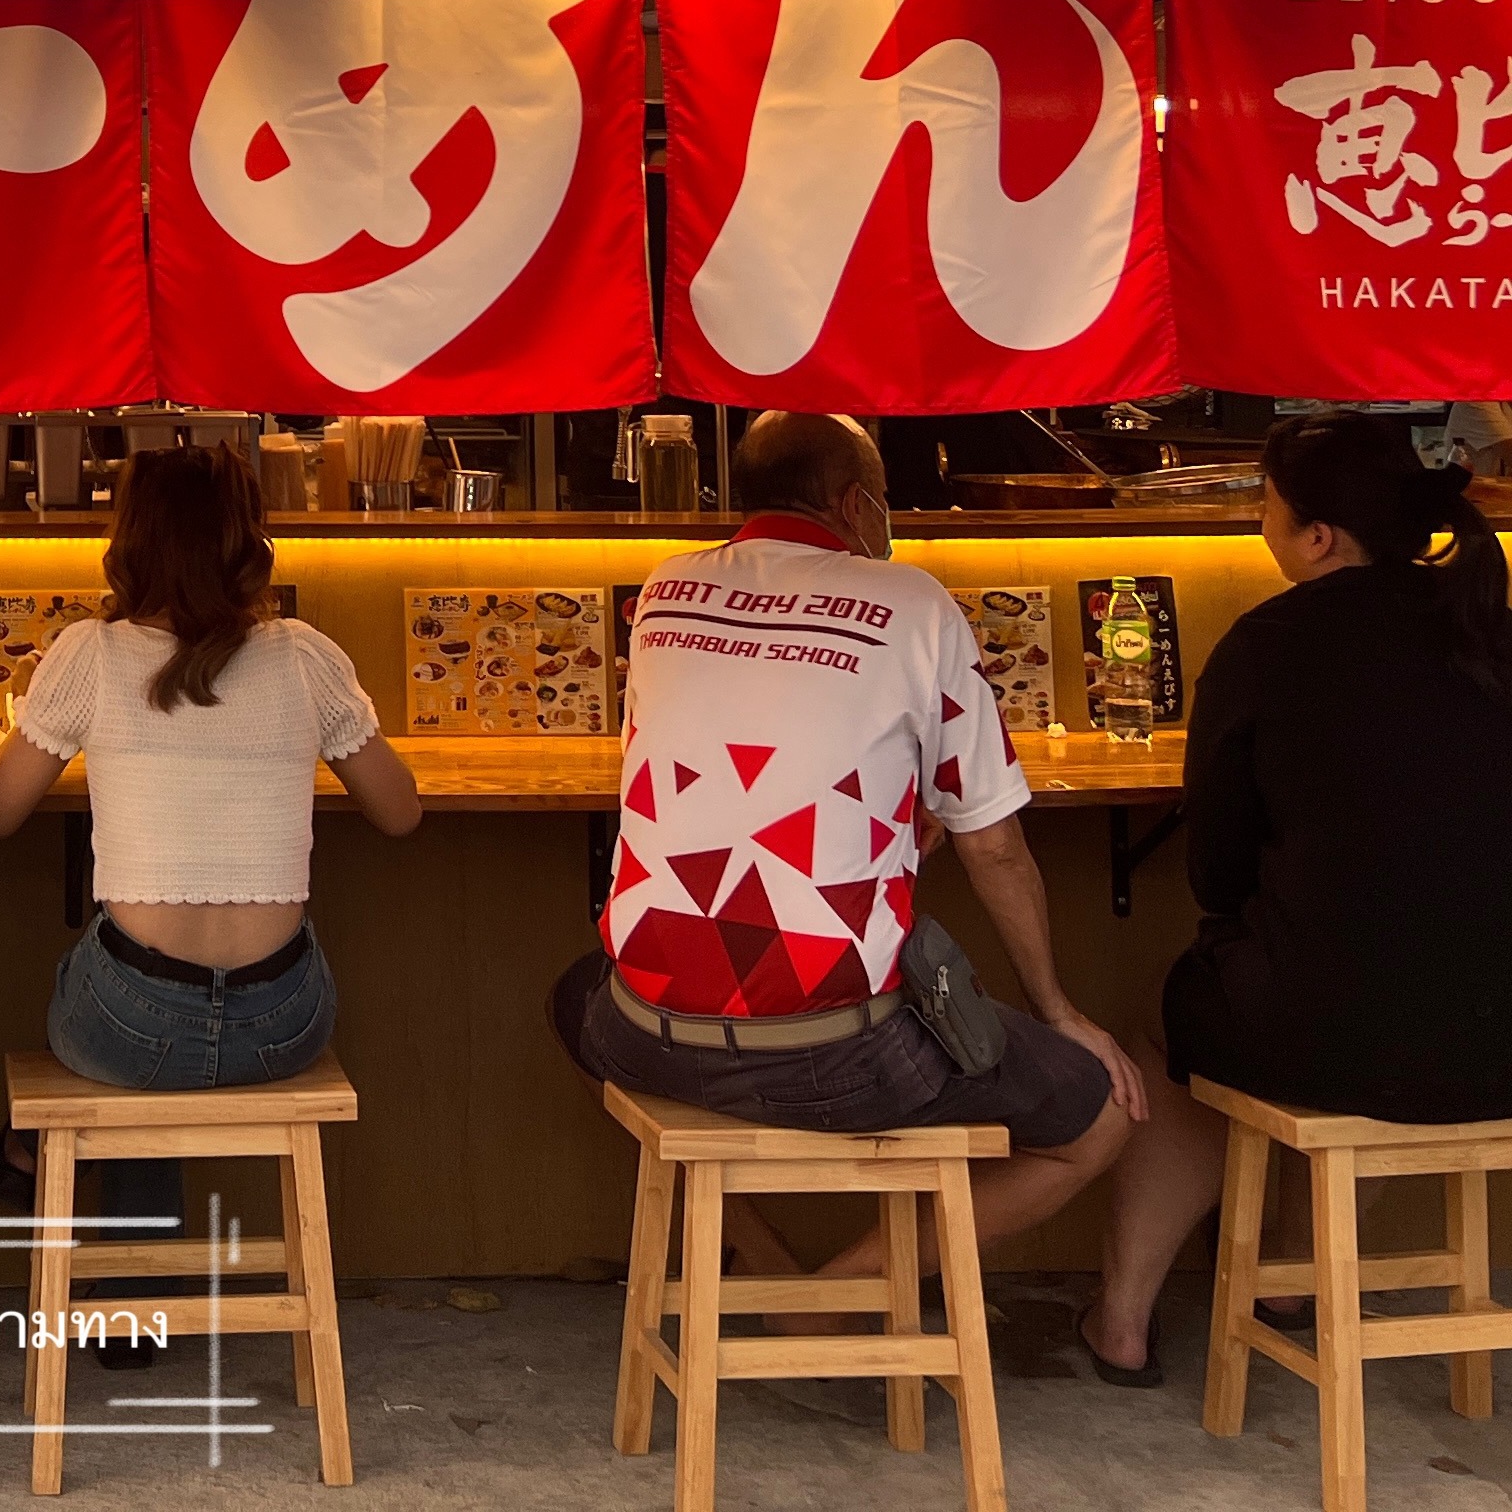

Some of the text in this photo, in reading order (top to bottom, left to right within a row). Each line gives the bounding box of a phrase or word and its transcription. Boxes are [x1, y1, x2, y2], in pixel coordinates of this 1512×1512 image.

[723, 588, 800, 615] DAY
[802, 593, 894, 630] 2018
[763, 642, 860, 675] SCHOOL
